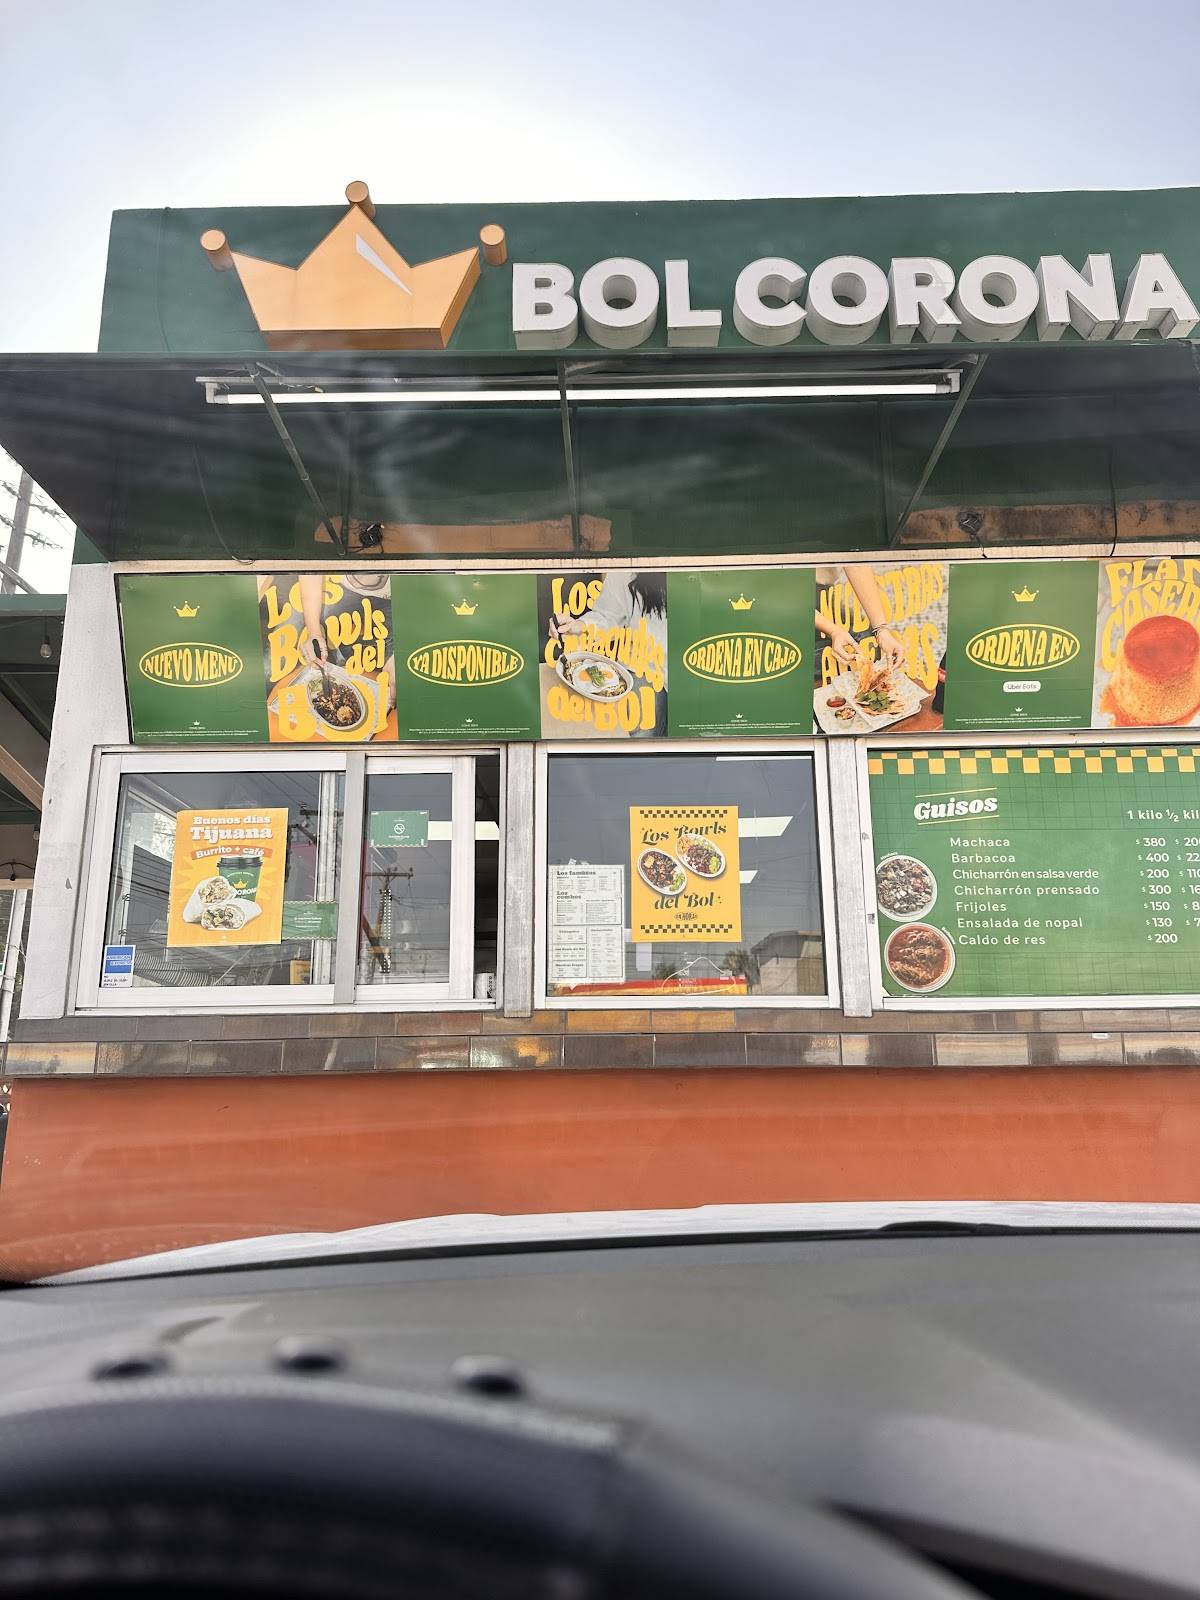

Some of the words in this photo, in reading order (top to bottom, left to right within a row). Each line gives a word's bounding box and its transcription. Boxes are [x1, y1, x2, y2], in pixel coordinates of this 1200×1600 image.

[513, 257, 722, 348] BOL
[733, 253, 1200, 346] CORONA
[1102, 580, 1200, 673] CASER
[972, 629, 1048, 667] ORDENA
[1048, 632, 1075, 664] EN
[144, 648, 191, 682] NUEVO
[195, 648, 238, 682] MENÚ
[345, 638, 386, 676] del
[412, 652, 429, 676] YA
[431, 644, 519, 682] DISPONIBLE
[688, 638, 741, 678] ORDENA
[743, 638, 761, 677] EN
[764, 639, 797, 674] CAJA
[913, 797, 998, 820] Guisos
[1127, 810, 1133, 819] 1
[1138, 810, 1163, 819] kilo
[193, 816, 240, 825] Buenos
[243, 815, 272, 824] días
[190, 826, 273, 844] Tijuana
[641, 827, 669, 845] Los
[950, 837, 1010, 847] Machaca
[1184, 838, 1200, 846] 20
[196, 846, 232, 858] Burrito
[243, 847, 265, 856] café
[951, 853, 1015, 863] Barbacoa
[953, 869, 1019, 879] Chicharrón
[1021, 871, 1035, 879] en
[1036, 869, 1065, 879] salsa
[1066, 869, 1099, 879] verde
[954, 885, 1032, 896] Chicharrón
[1036, 885, 1100, 896] prensado
[654, 894, 679, 909] del
[684, 892, 714, 908] Bol
[956, 901, 1007, 913] Frijoles
[957, 918, 1019, 928] Ensalada
[1024, 918, 1040, 928] de
[1045, 917, 1083, 929] nopal
[959, 934, 999, 945] Caldo
[1003, 935, 1020, 945] de
[1024, 936, 1046, 945] res
